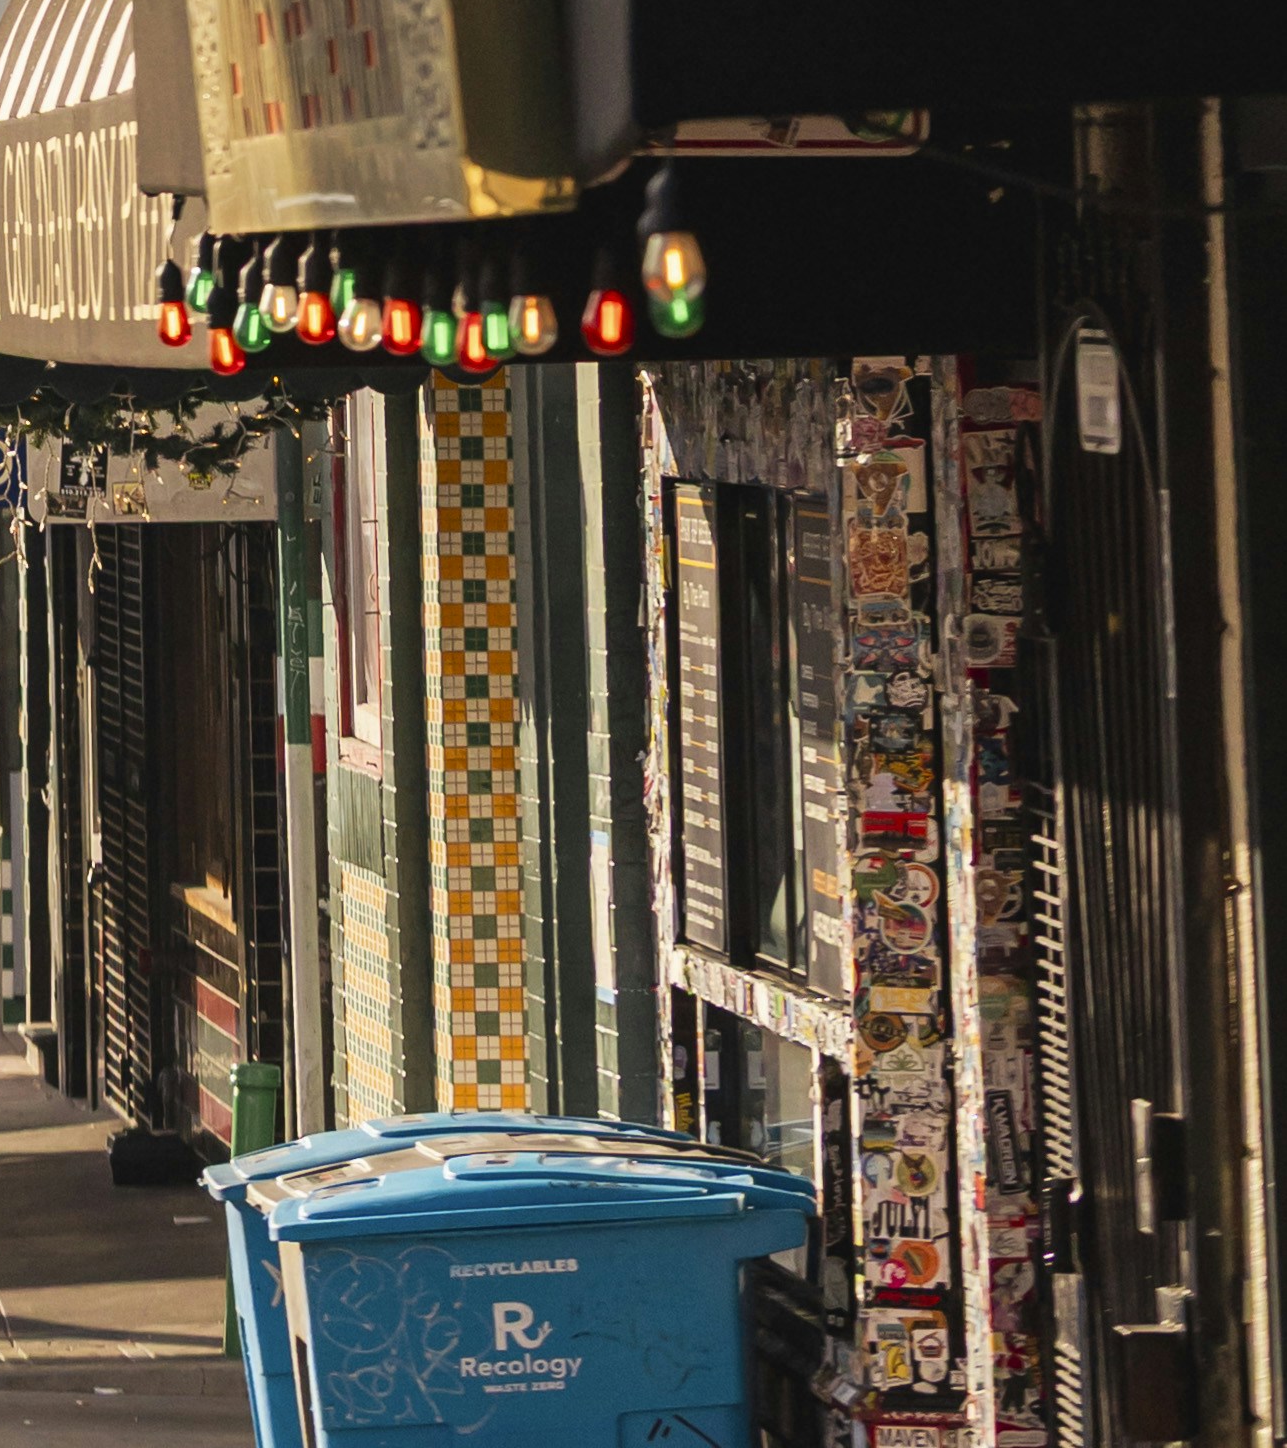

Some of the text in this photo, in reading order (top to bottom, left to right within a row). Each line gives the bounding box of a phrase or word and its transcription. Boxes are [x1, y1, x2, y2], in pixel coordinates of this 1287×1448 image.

[3, 132, 75, 324] GOLDEN
[75, 125, 117, 322] BOY
[449, 1258, 580, 1278] RECYCLABLES
[458, 1353, 583, 1379] Recology
